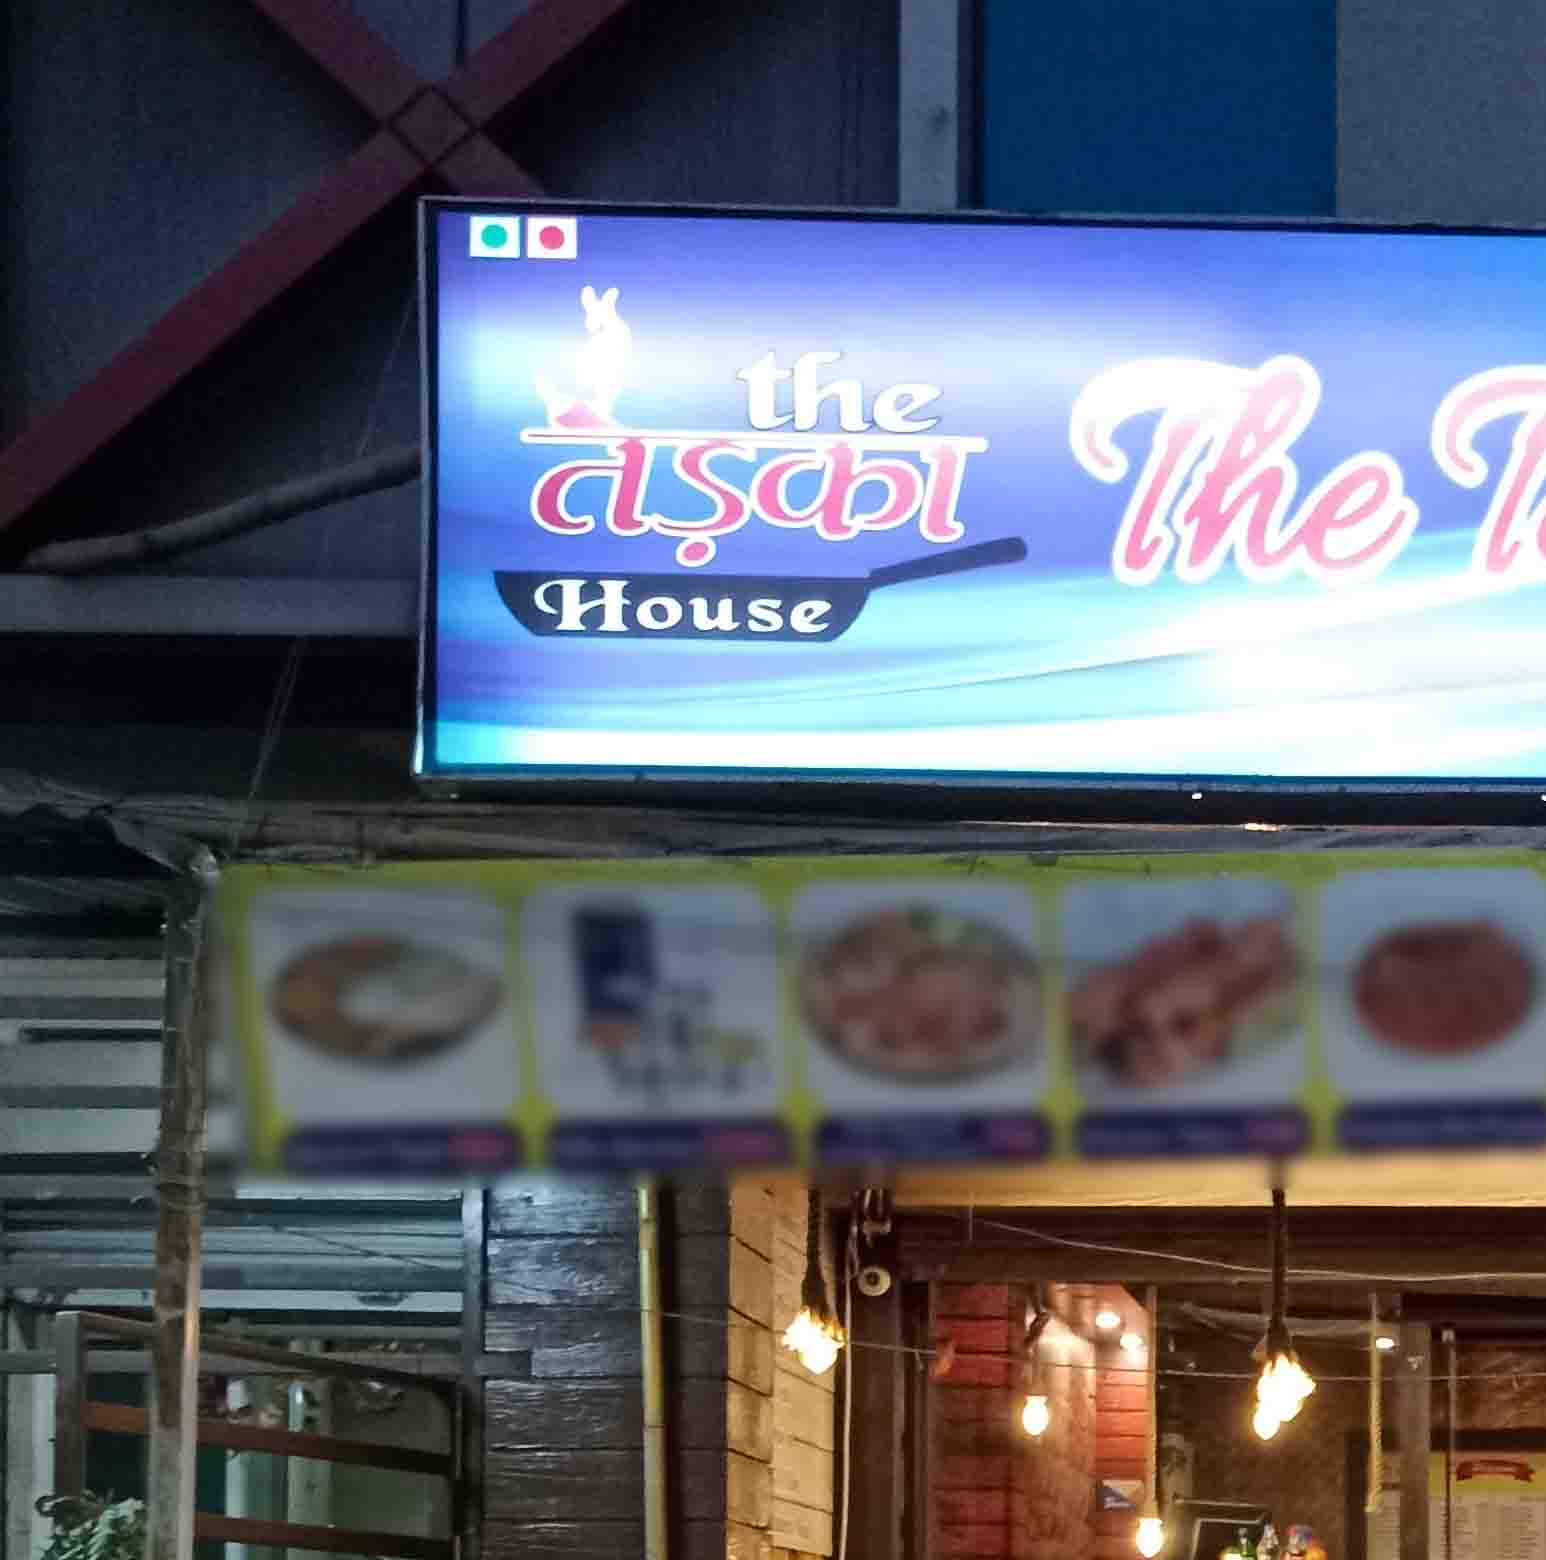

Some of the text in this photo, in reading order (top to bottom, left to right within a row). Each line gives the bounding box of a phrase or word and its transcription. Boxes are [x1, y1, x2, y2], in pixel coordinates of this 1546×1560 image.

[735, 351, 943, 433] the
[1069, 353, 1419, 587] The
[533, 578, 832, 634] House
